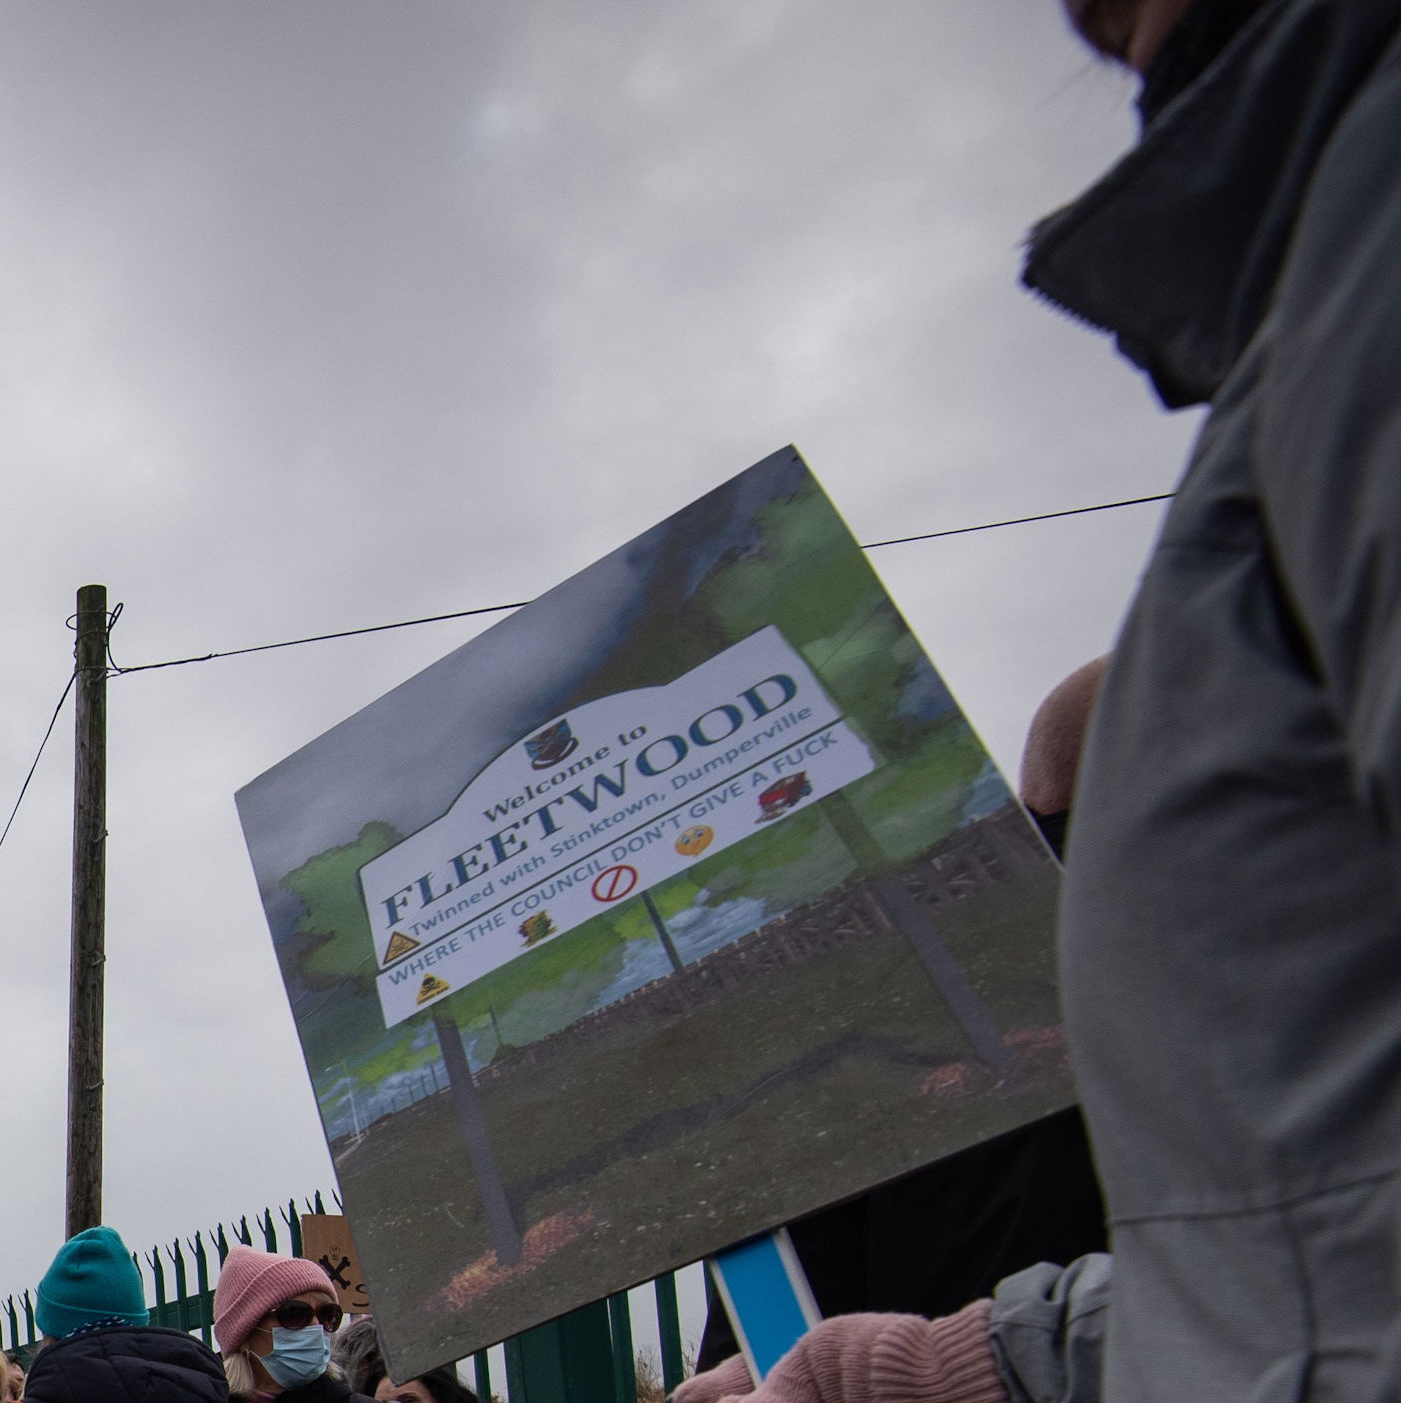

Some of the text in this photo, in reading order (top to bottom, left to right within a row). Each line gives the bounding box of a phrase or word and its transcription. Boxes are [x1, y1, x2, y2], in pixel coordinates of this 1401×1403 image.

[380, 673, 797, 930] FLEETWOOD
[388, 730, 839, 985] WHERE THE COUNCIL DON'T GIVE A FUCK
[408, 706, 812, 937] Twinned with Stinktown, Dumperville
[482, 725, 647, 822] Welcome to
